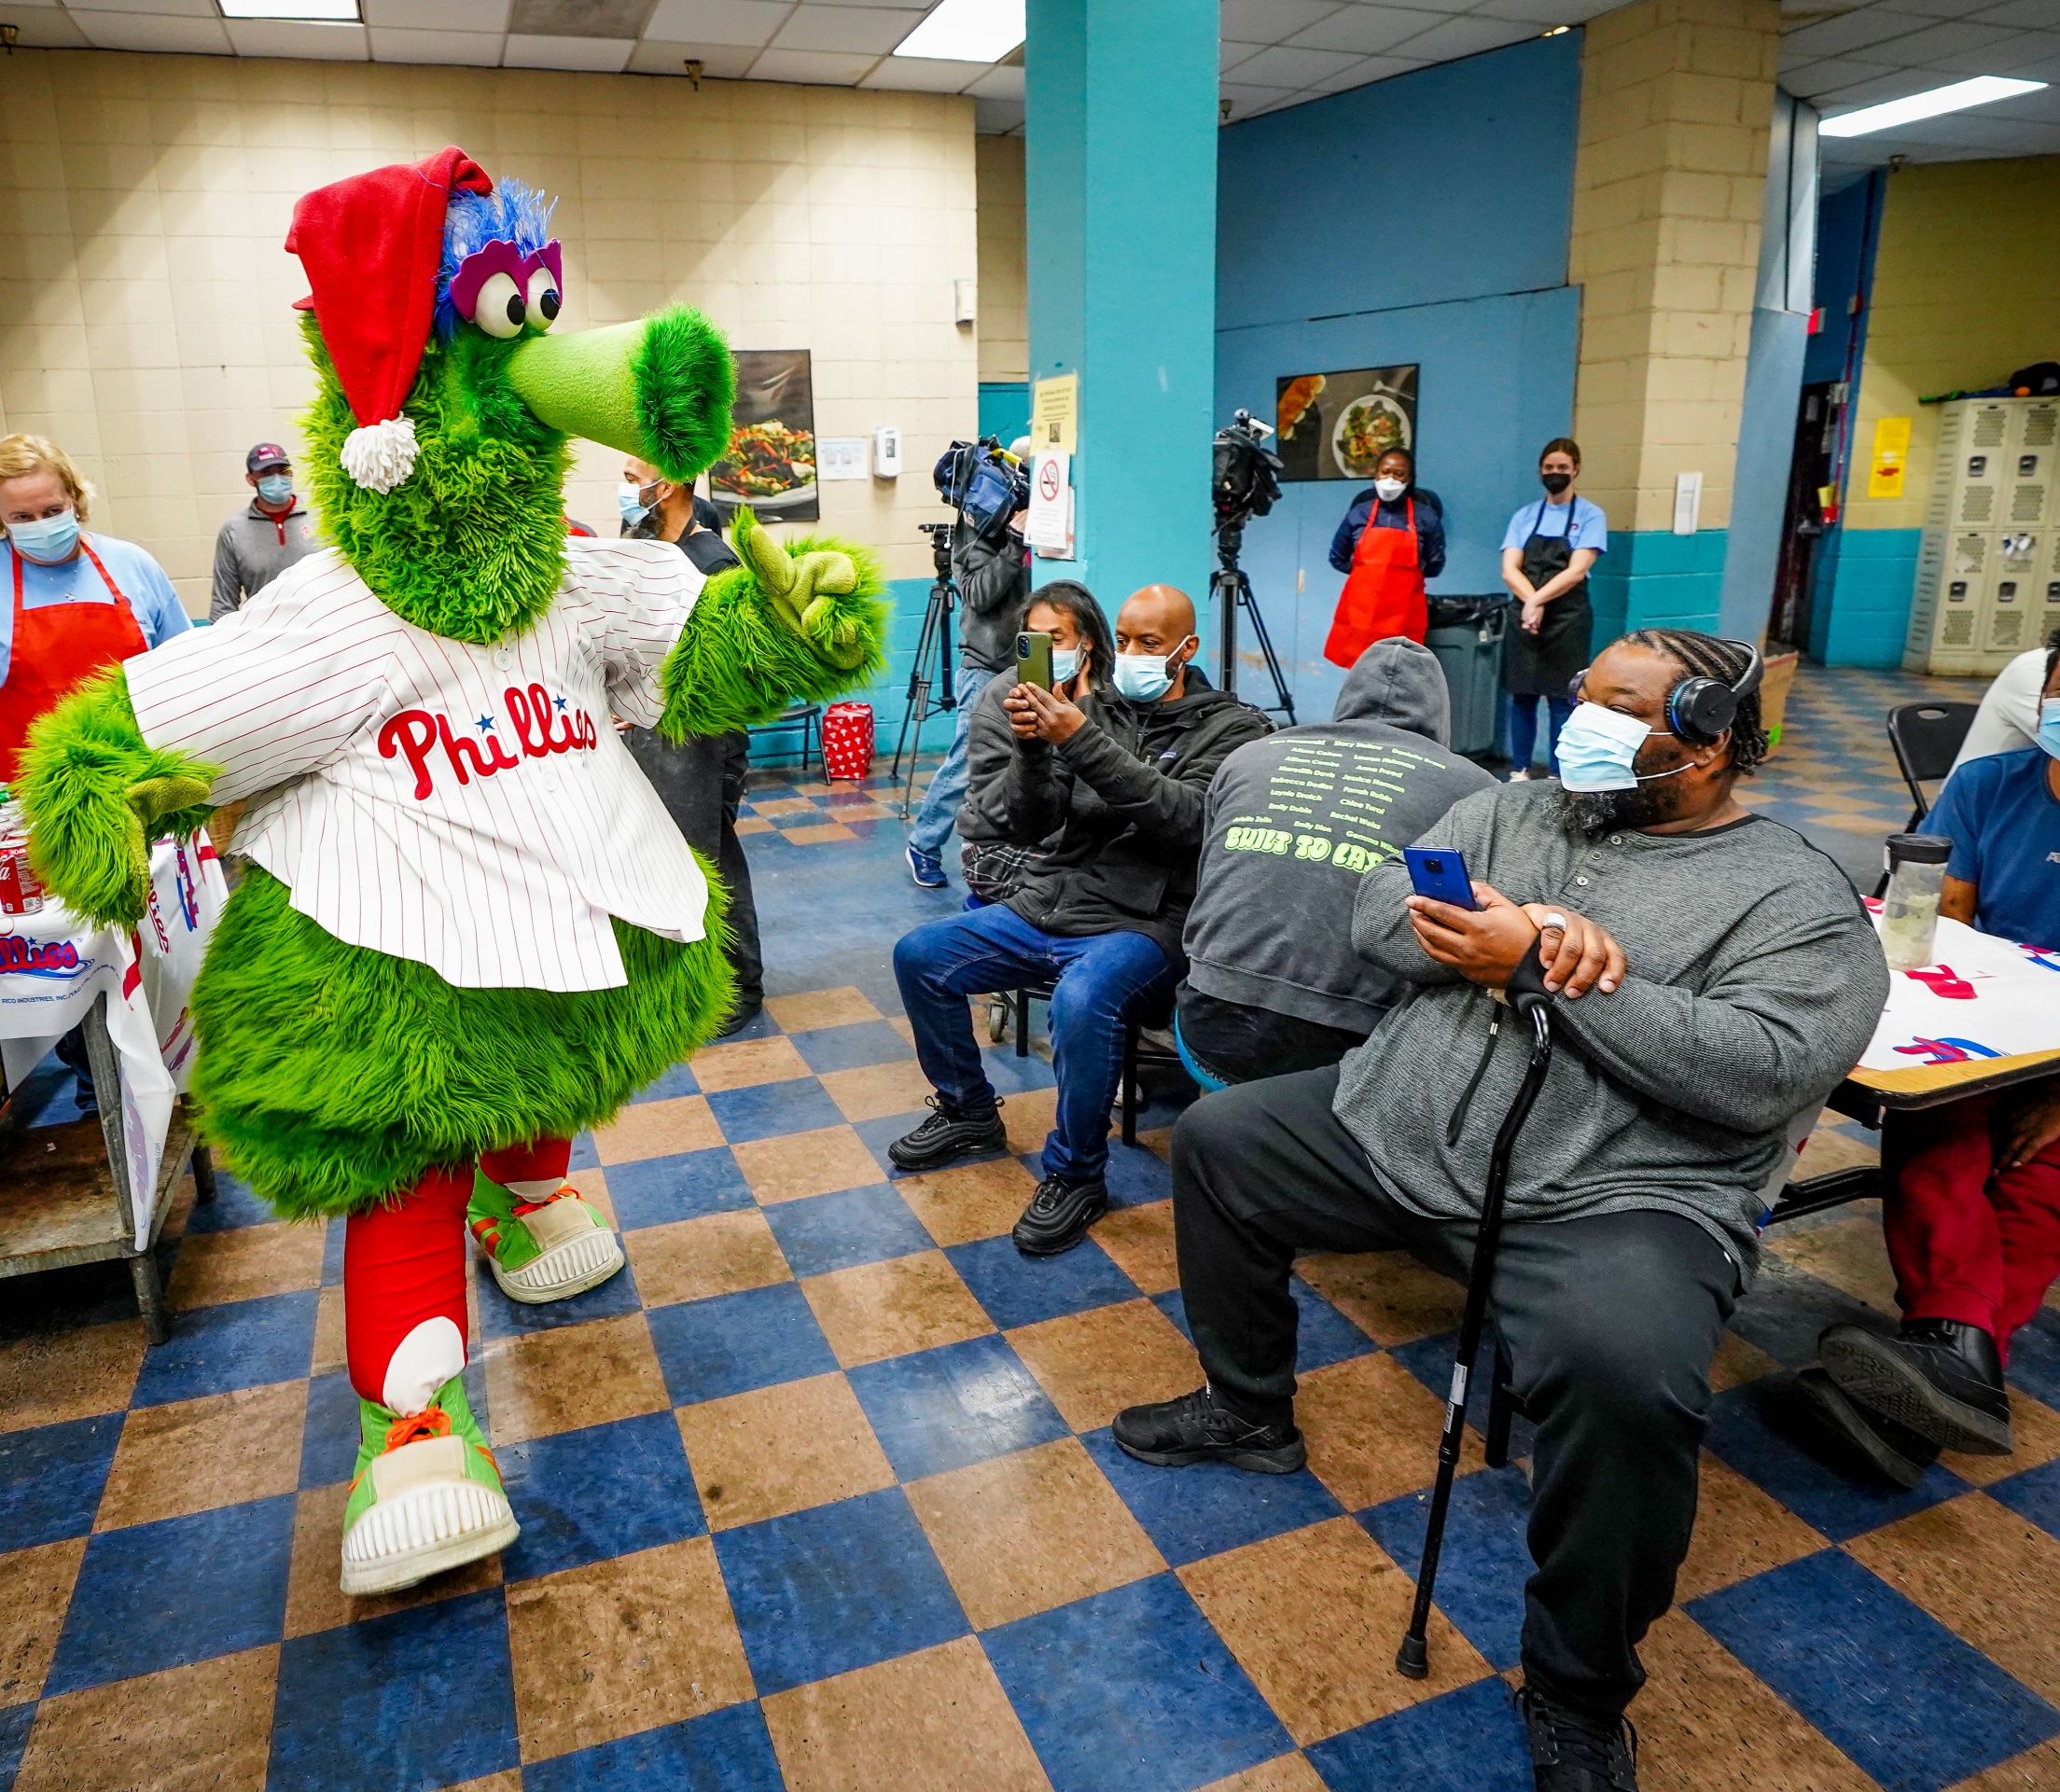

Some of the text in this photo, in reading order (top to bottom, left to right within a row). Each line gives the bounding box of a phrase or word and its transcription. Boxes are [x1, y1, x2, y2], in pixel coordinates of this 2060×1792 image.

[377, 682, 598, 801] Phillies
[1270, 776, 1306, 786] Rebecca
[1293, 820, 1315, 830] Emily
[1224, 827, 1385, 874] BUILT TO LAS
[0, 935, 78, 974] llies
